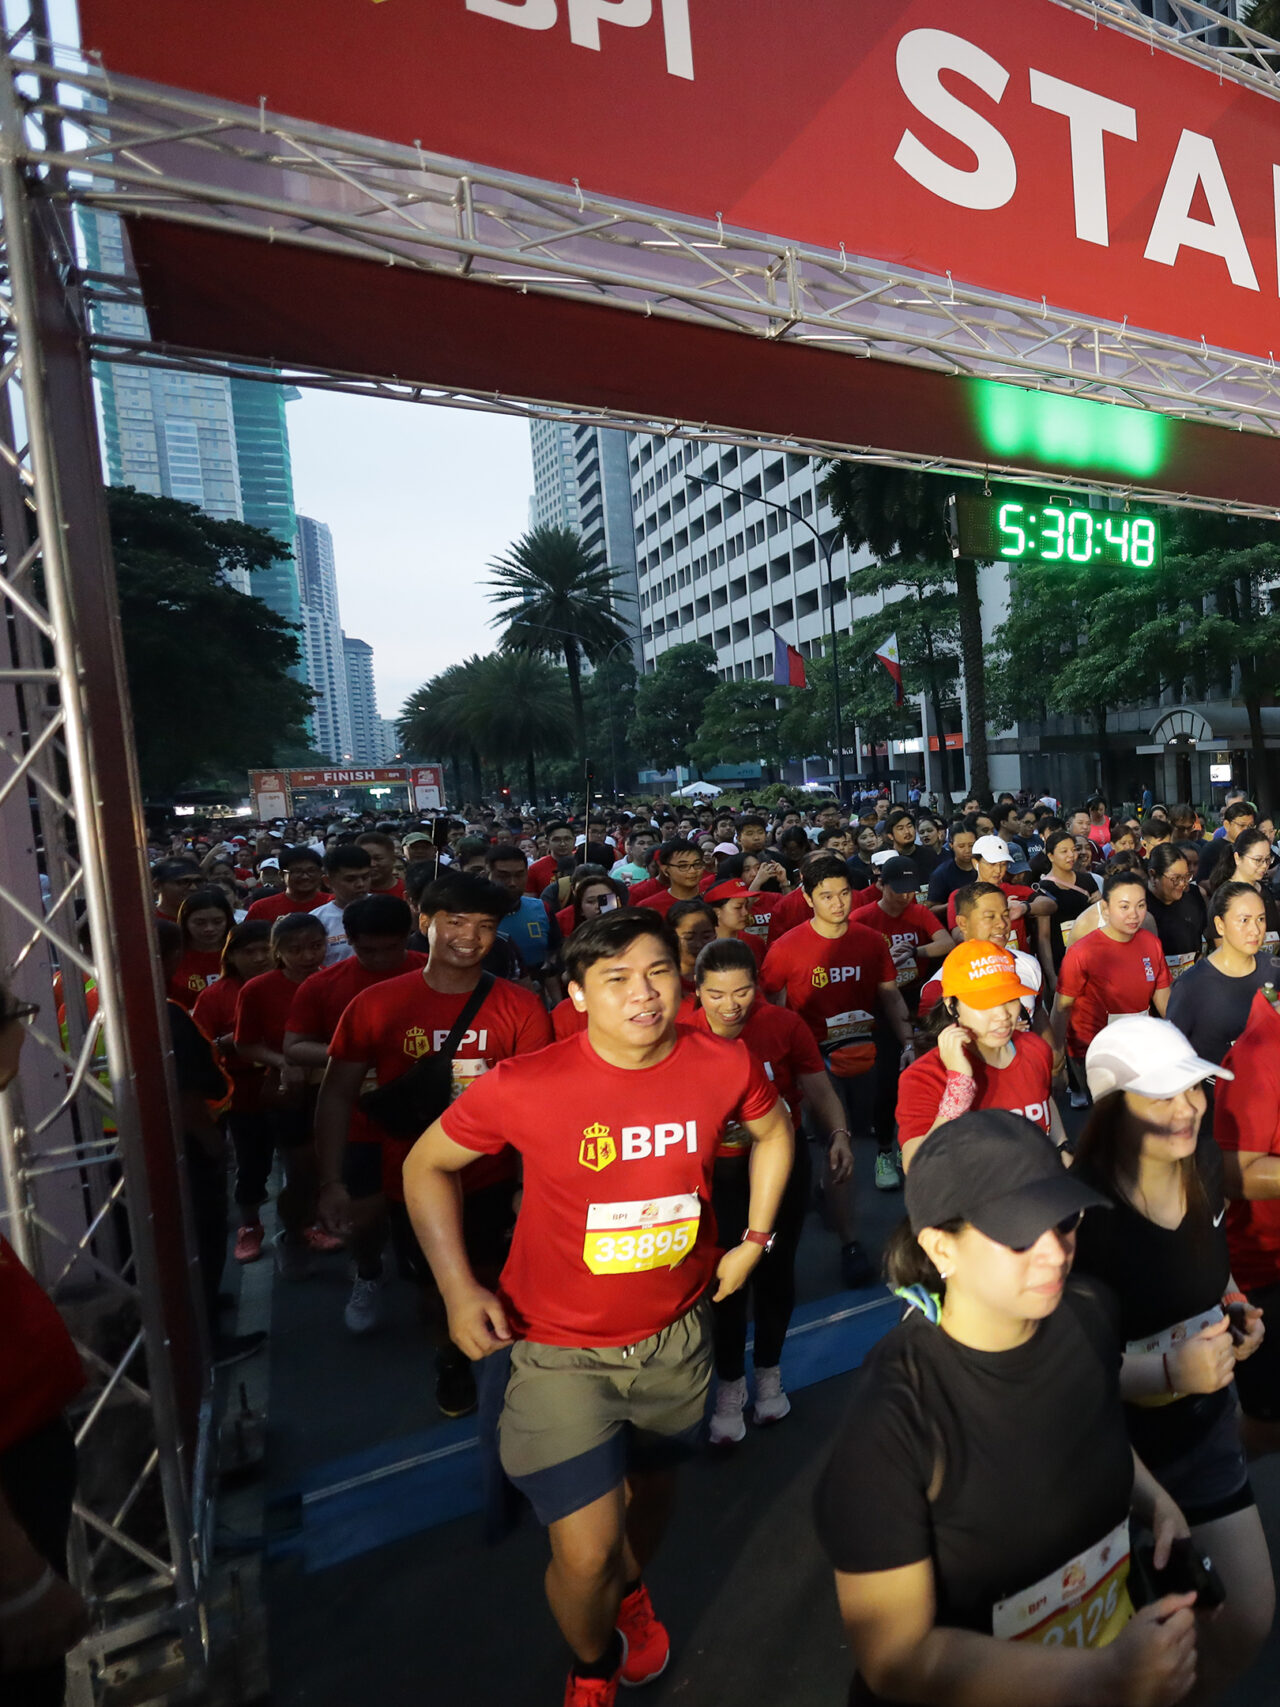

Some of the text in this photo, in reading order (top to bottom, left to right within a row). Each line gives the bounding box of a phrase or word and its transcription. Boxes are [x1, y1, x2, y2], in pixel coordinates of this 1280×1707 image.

[466, 0, 694, 81] PI
[999, 503, 1155, 567] 5:30:48
[324, 771, 376, 782] FINISH
[755, 913, 771, 925] BP
[970, 955, 1010, 970] MAGING
[829, 966, 861, 983] BPI
[968, 964, 1015, 981] MAGITING
[621, 1120, 698, 1161] BPI
[612, 1213, 628, 1221] BPI
[594, 1227, 689, 1263] 33895
[1028, 1596, 1048, 1615] BPI
